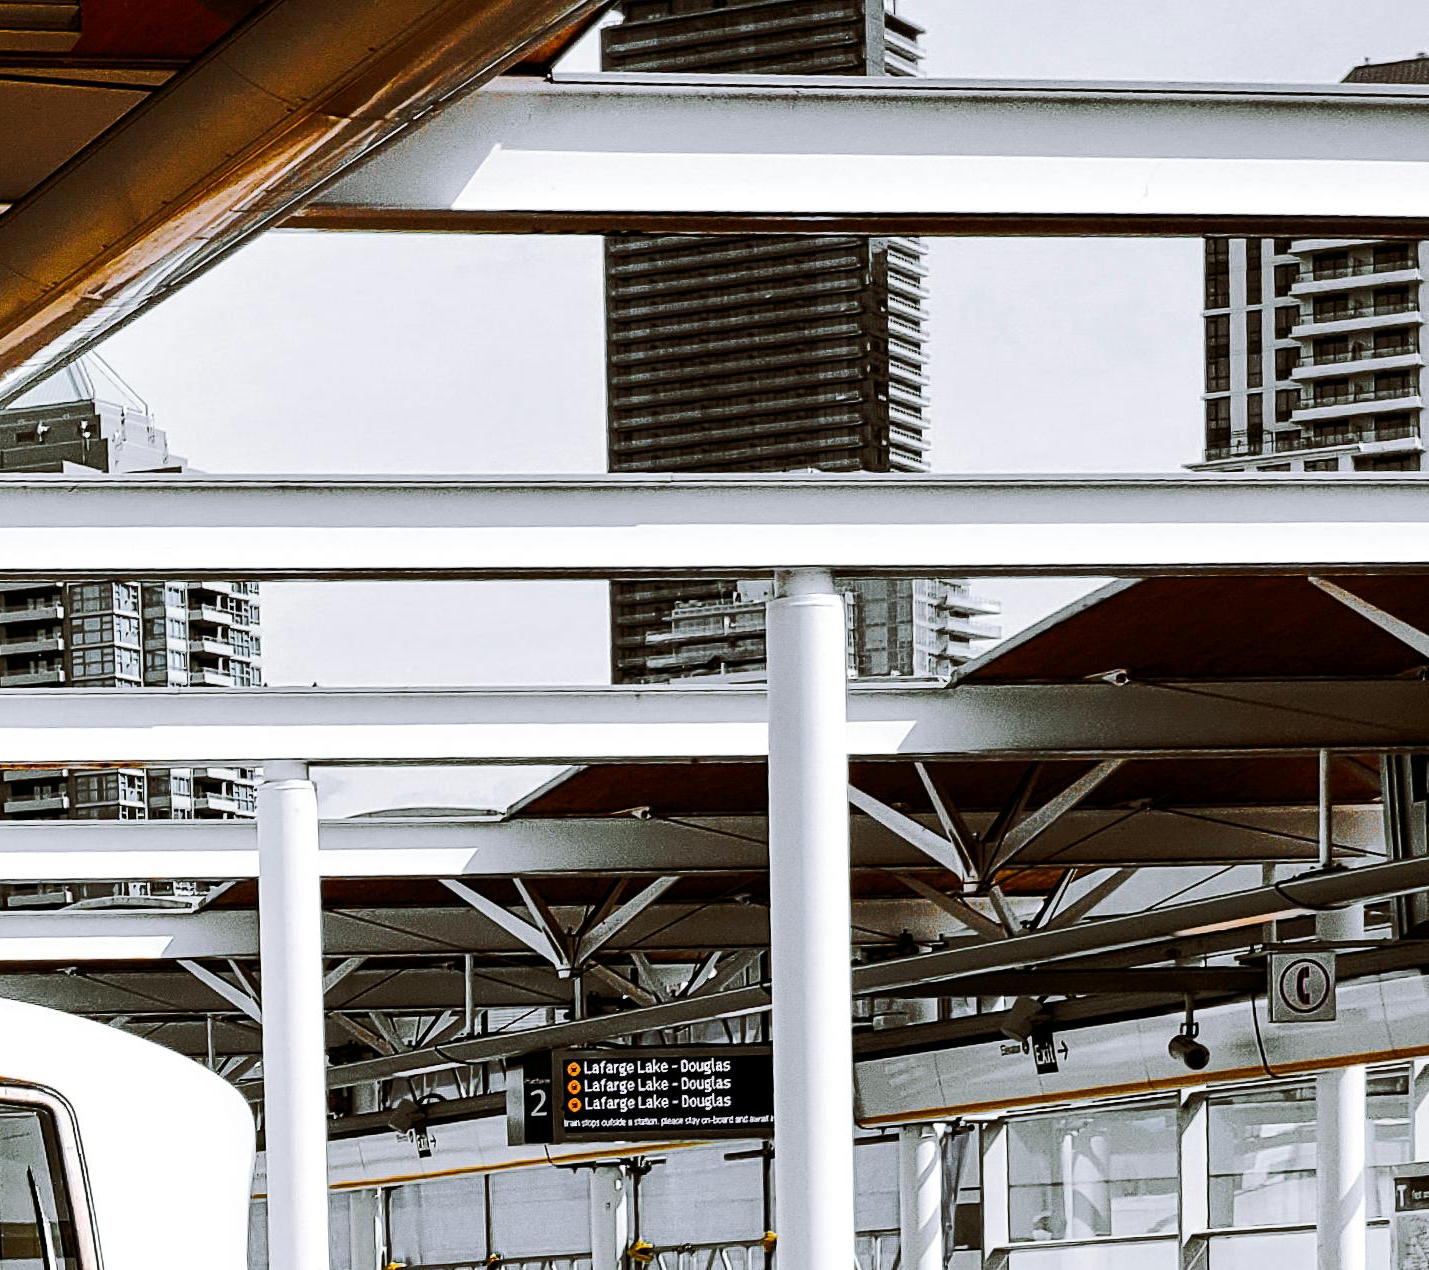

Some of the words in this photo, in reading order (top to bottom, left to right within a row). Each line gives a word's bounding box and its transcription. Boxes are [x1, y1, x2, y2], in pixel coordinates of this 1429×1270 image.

[584, 1060, 635, 1076] Lafarge
[637, 1058, 669, 1074] Lake
[680, 1057, 731, 1075] Douglas
[584, 1078, 635, 1095] Lafarge
[637, 1076, 669, 1091] Lake
[681, 1075, 732, 1092] Douglas
[530, 1089, 548, 1117] 2
[584, 1096, 636, 1112] Lafarge
[637, 1094, 669, 1109] Lake
[681, 1093, 732, 1110] Douglas
[601, 1118, 626, 1127] outside
